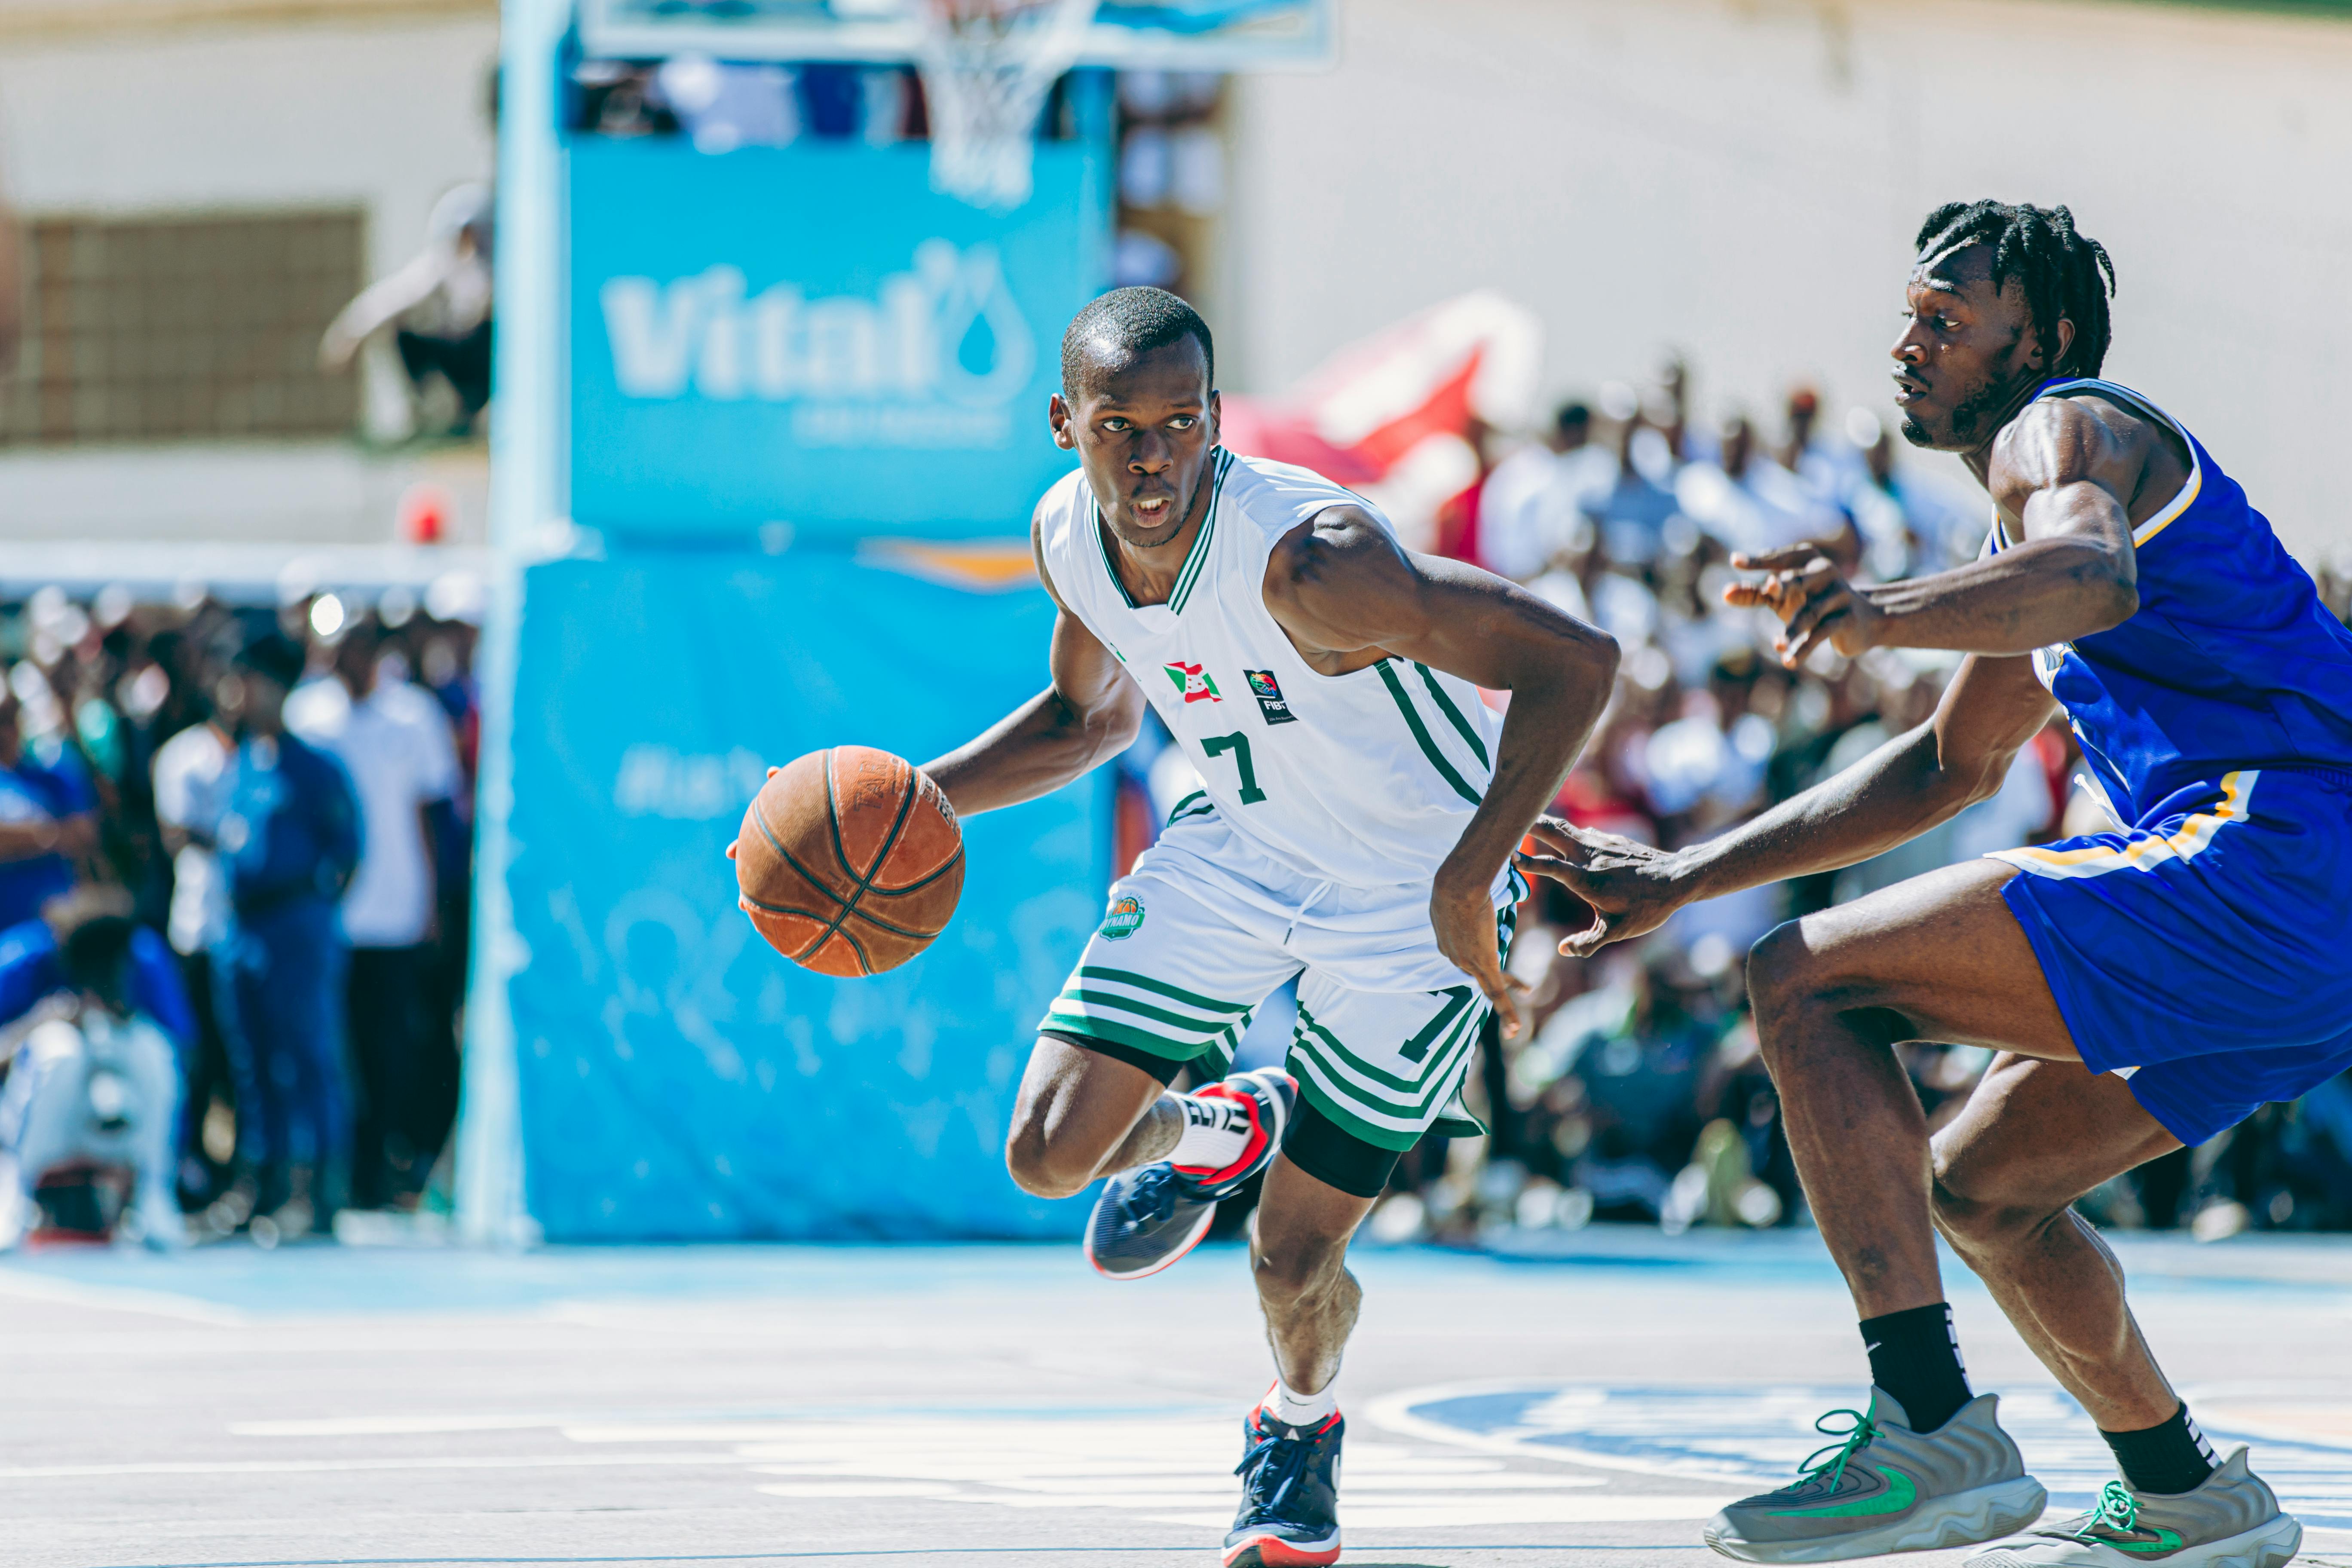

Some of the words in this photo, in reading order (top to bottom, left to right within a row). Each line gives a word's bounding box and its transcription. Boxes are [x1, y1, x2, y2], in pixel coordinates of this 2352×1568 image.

[603, 264, 936, 398] Vital
[1200, 731, 1267, 805] 7
[1398, 985, 1473, 1065] 7
